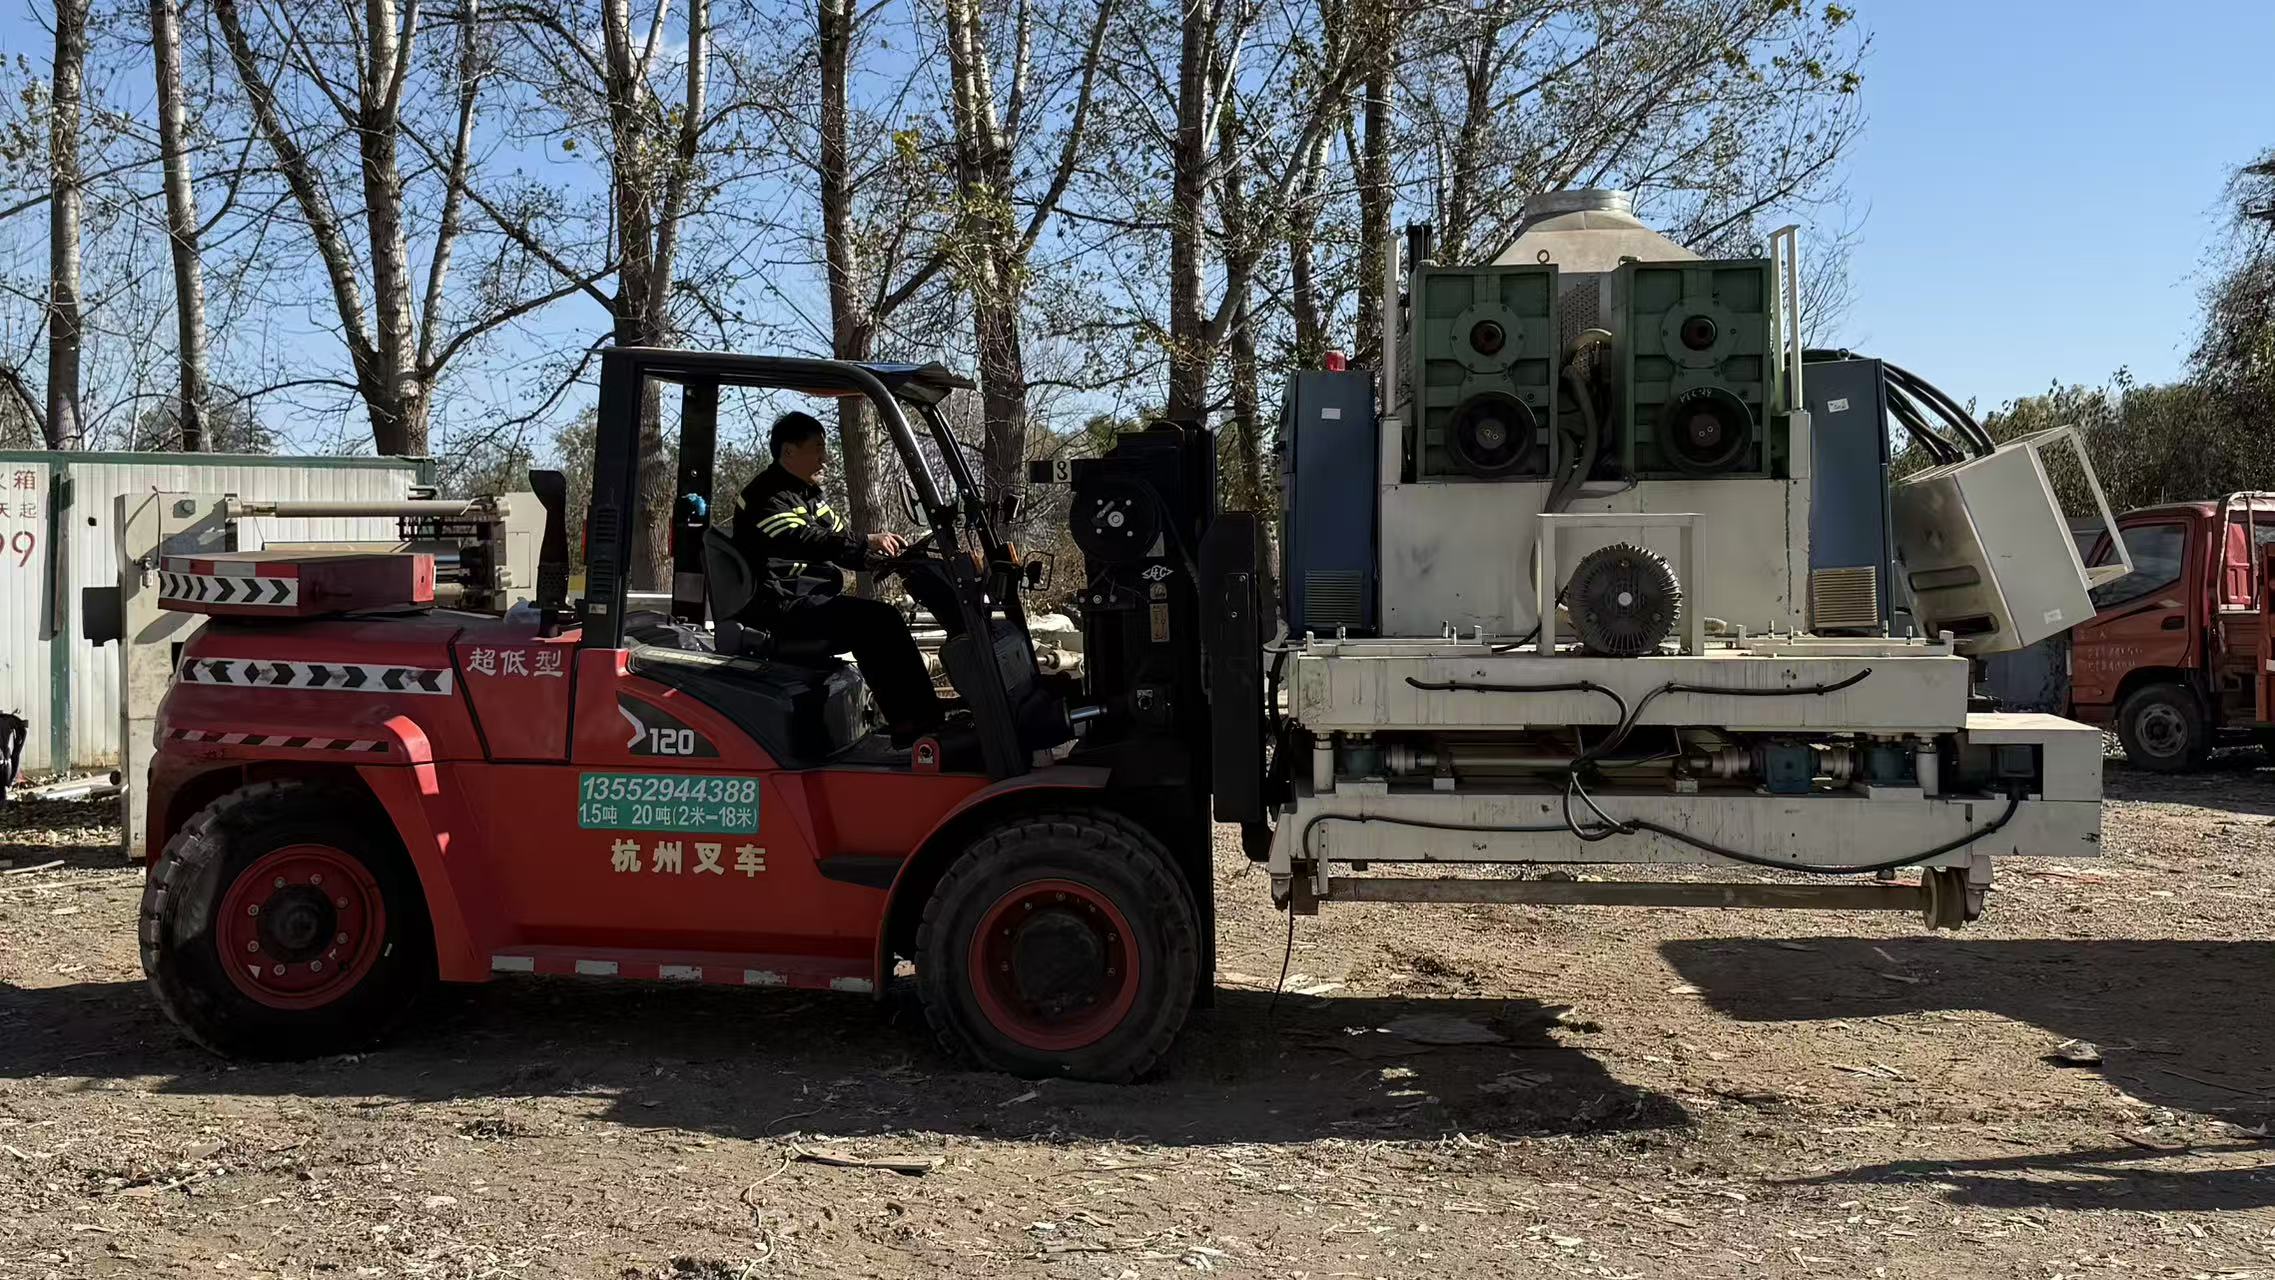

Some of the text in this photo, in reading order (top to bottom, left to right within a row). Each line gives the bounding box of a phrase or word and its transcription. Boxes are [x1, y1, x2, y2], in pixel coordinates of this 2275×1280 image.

[466, 647, 563, 677] 超低型
[650, 727, 695, 755] 120
[583, 776, 756, 803] 13552944388
[579, 803, 618, 825] 1.5吨
[611, 838, 766, 878] 杭州叉车
